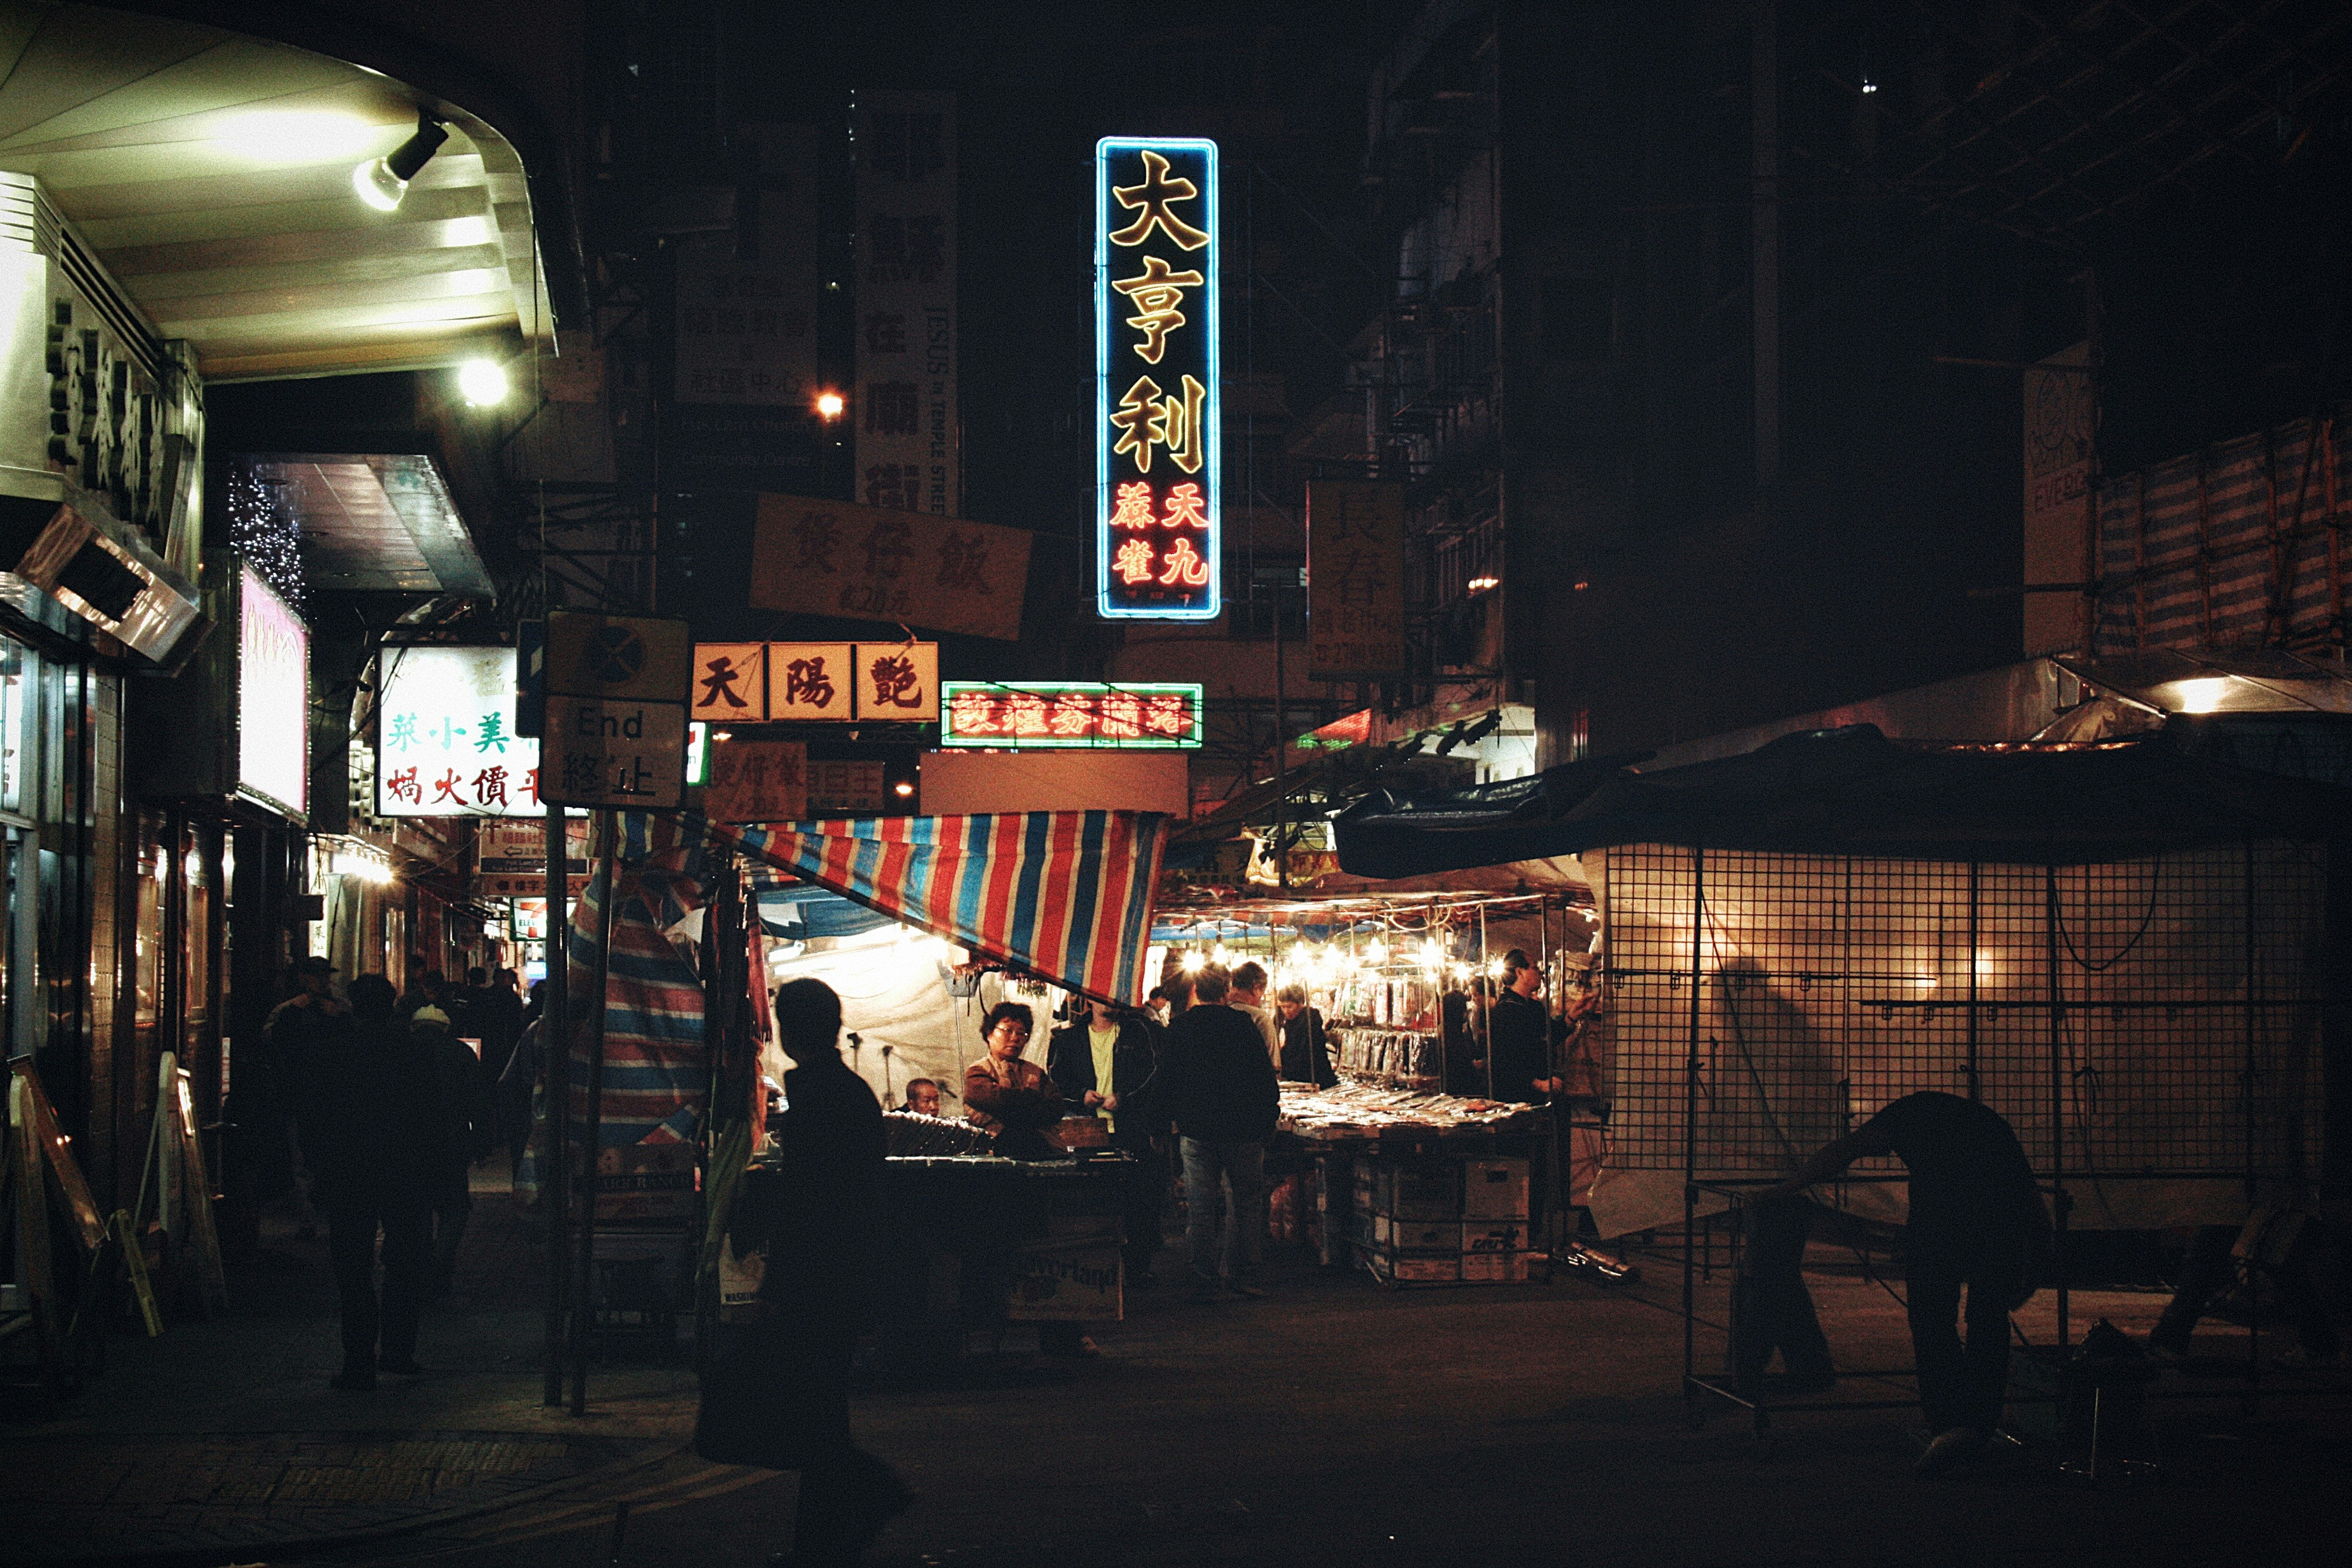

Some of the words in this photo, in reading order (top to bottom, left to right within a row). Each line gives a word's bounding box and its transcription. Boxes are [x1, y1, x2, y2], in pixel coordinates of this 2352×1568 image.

[926, 305, 949, 374] JESUS
[1109, 150, 1210, 473] 大亨利
[930, 400, 946, 458] TEMPLE
[1158, 482, 1210, 586] 天九
[386, 711, 540, 754] 美小菜
[579, 707, 643, 739] End
[563, 750, 656, 796] 終止
